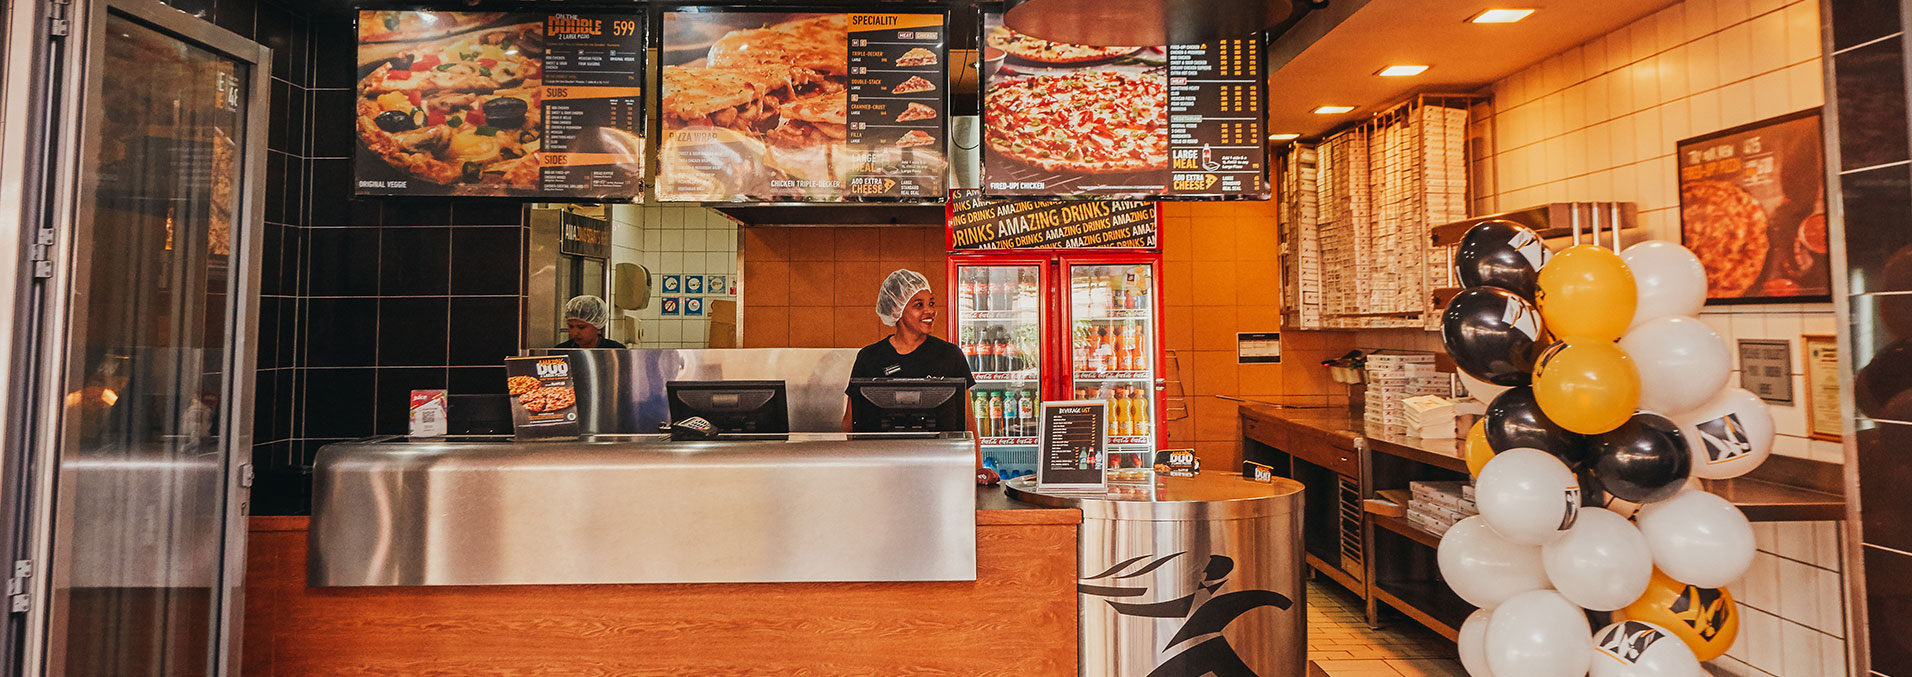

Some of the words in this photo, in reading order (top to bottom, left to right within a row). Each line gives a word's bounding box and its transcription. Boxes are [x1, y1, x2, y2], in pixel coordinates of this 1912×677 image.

[852, 15, 898, 25] SPECIALITY
[548, 16, 602, 36] DOUBLE
[613, 20, 635, 36] 599
[546, 88, 568, 97] SUBS
[669, 132, 692, 142] PZZA
[544, 155, 568, 164] SIDES
[852, 154, 876, 162] LARGE
[1173, 150, 1198, 159] LARGE
[1173, 159, 1198, 169] MEAL
[852, 184, 882, 193] CHEESE
[1174, 181, 1205, 190] CHEESE
[953, 200, 971, 212] INKS
[967, 208, 995, 223] DRINKS
[997, 201, 1033, 217] AMAZING
[998, 209, 1059, 238] AMAZING
[1061, 201, 1110, 224] DRINKS
[1015, 232, 1043, 246] DRINKS
[1046, 224, 1081, 240] AMAZING
[1082, 218, 1111, 233] DRINKS
[1112, 209, 1149, 226] AMAZING
[1065, 234, 1101, 248] AMAZING
[1102, 228, 1131, 241] DRINKS
[1132, 222, 1155, 236] AMAZ
[536, 363, 568, 375] DUO
[1170, 453, 1193, 463] DUO
